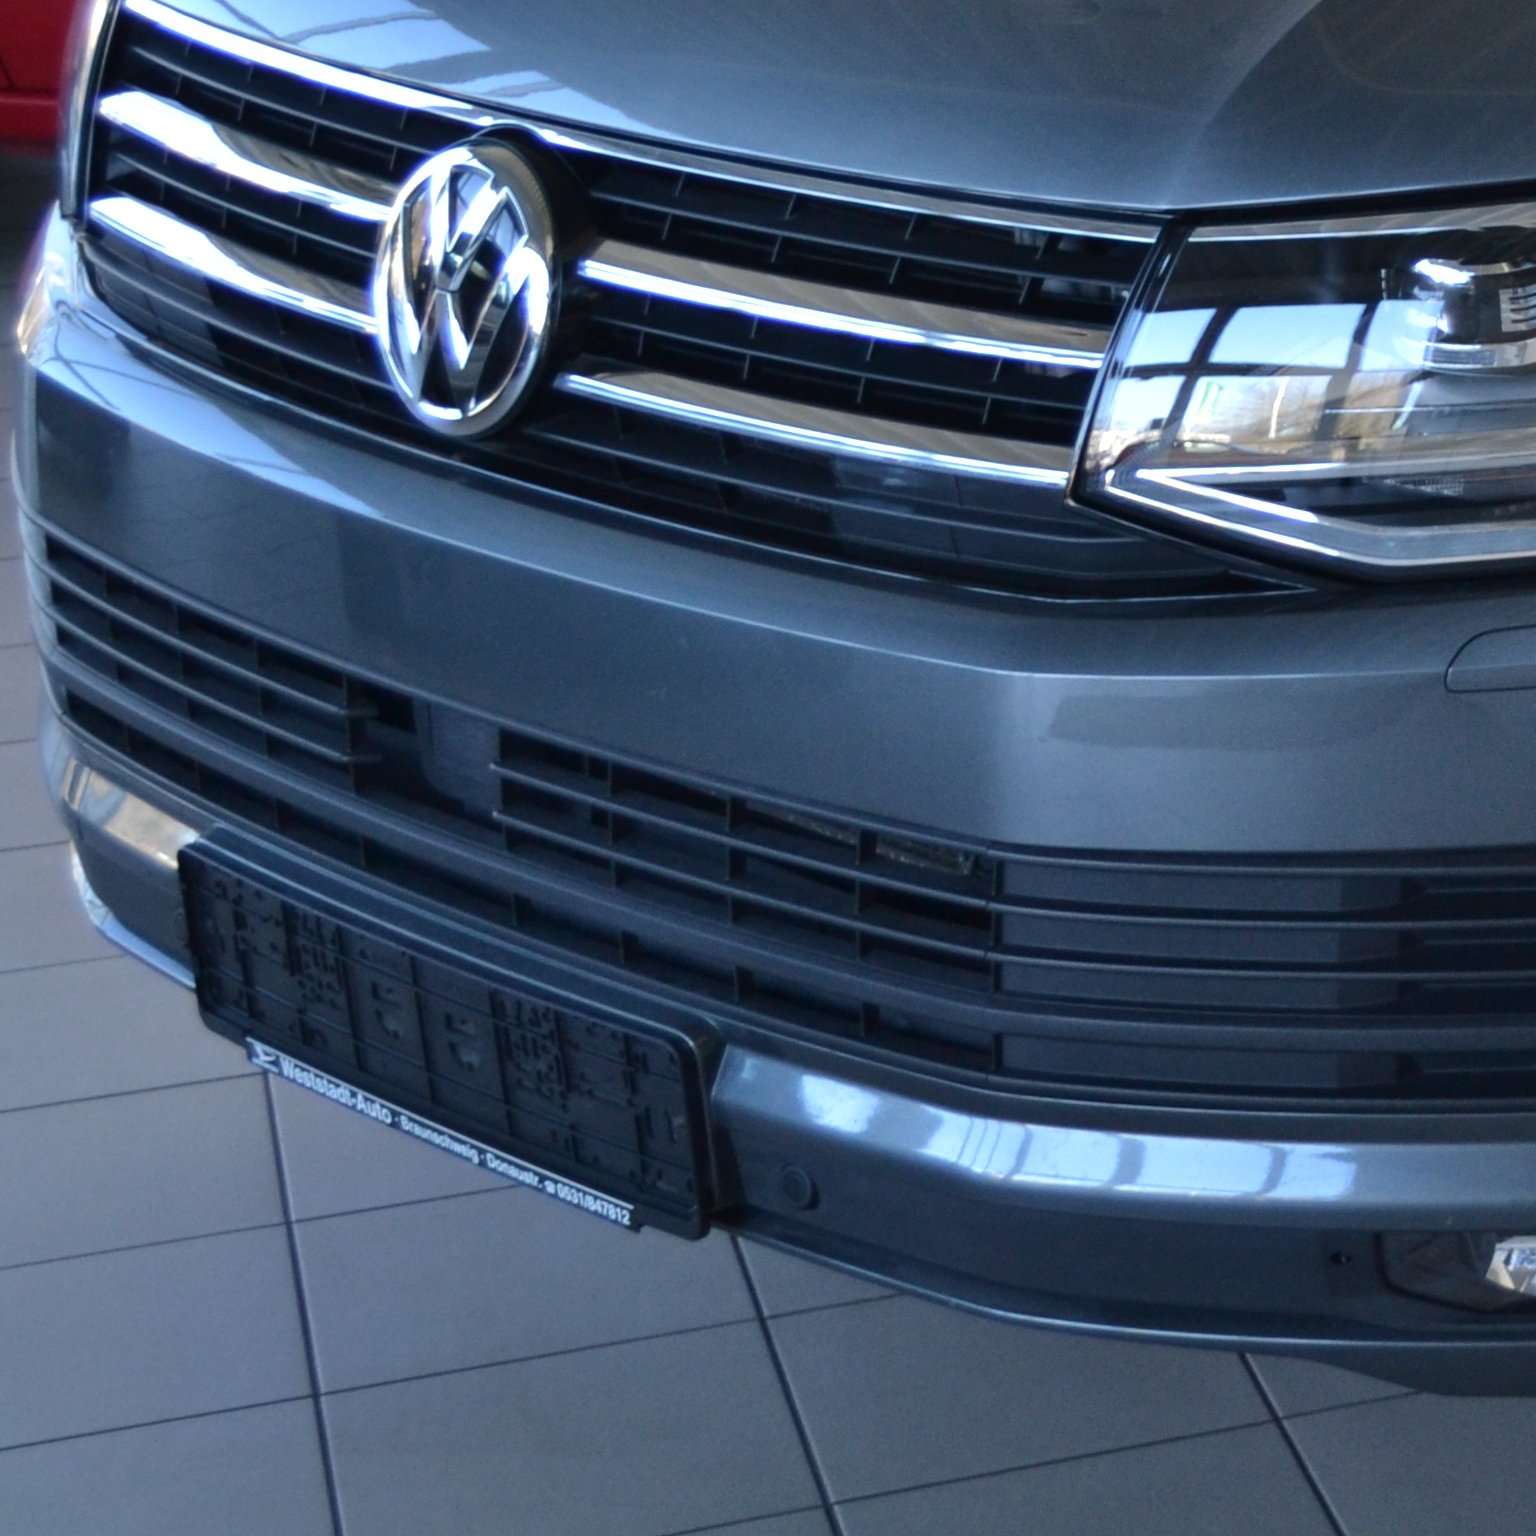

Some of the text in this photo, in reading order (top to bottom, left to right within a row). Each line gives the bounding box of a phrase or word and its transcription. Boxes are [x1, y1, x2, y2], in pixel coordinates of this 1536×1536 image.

[376, 142, 555, 436] VW
[279, 1054, 393, 1125] Weststadt-Auto
[400, 1114, 480, 1165] Braunschweig
